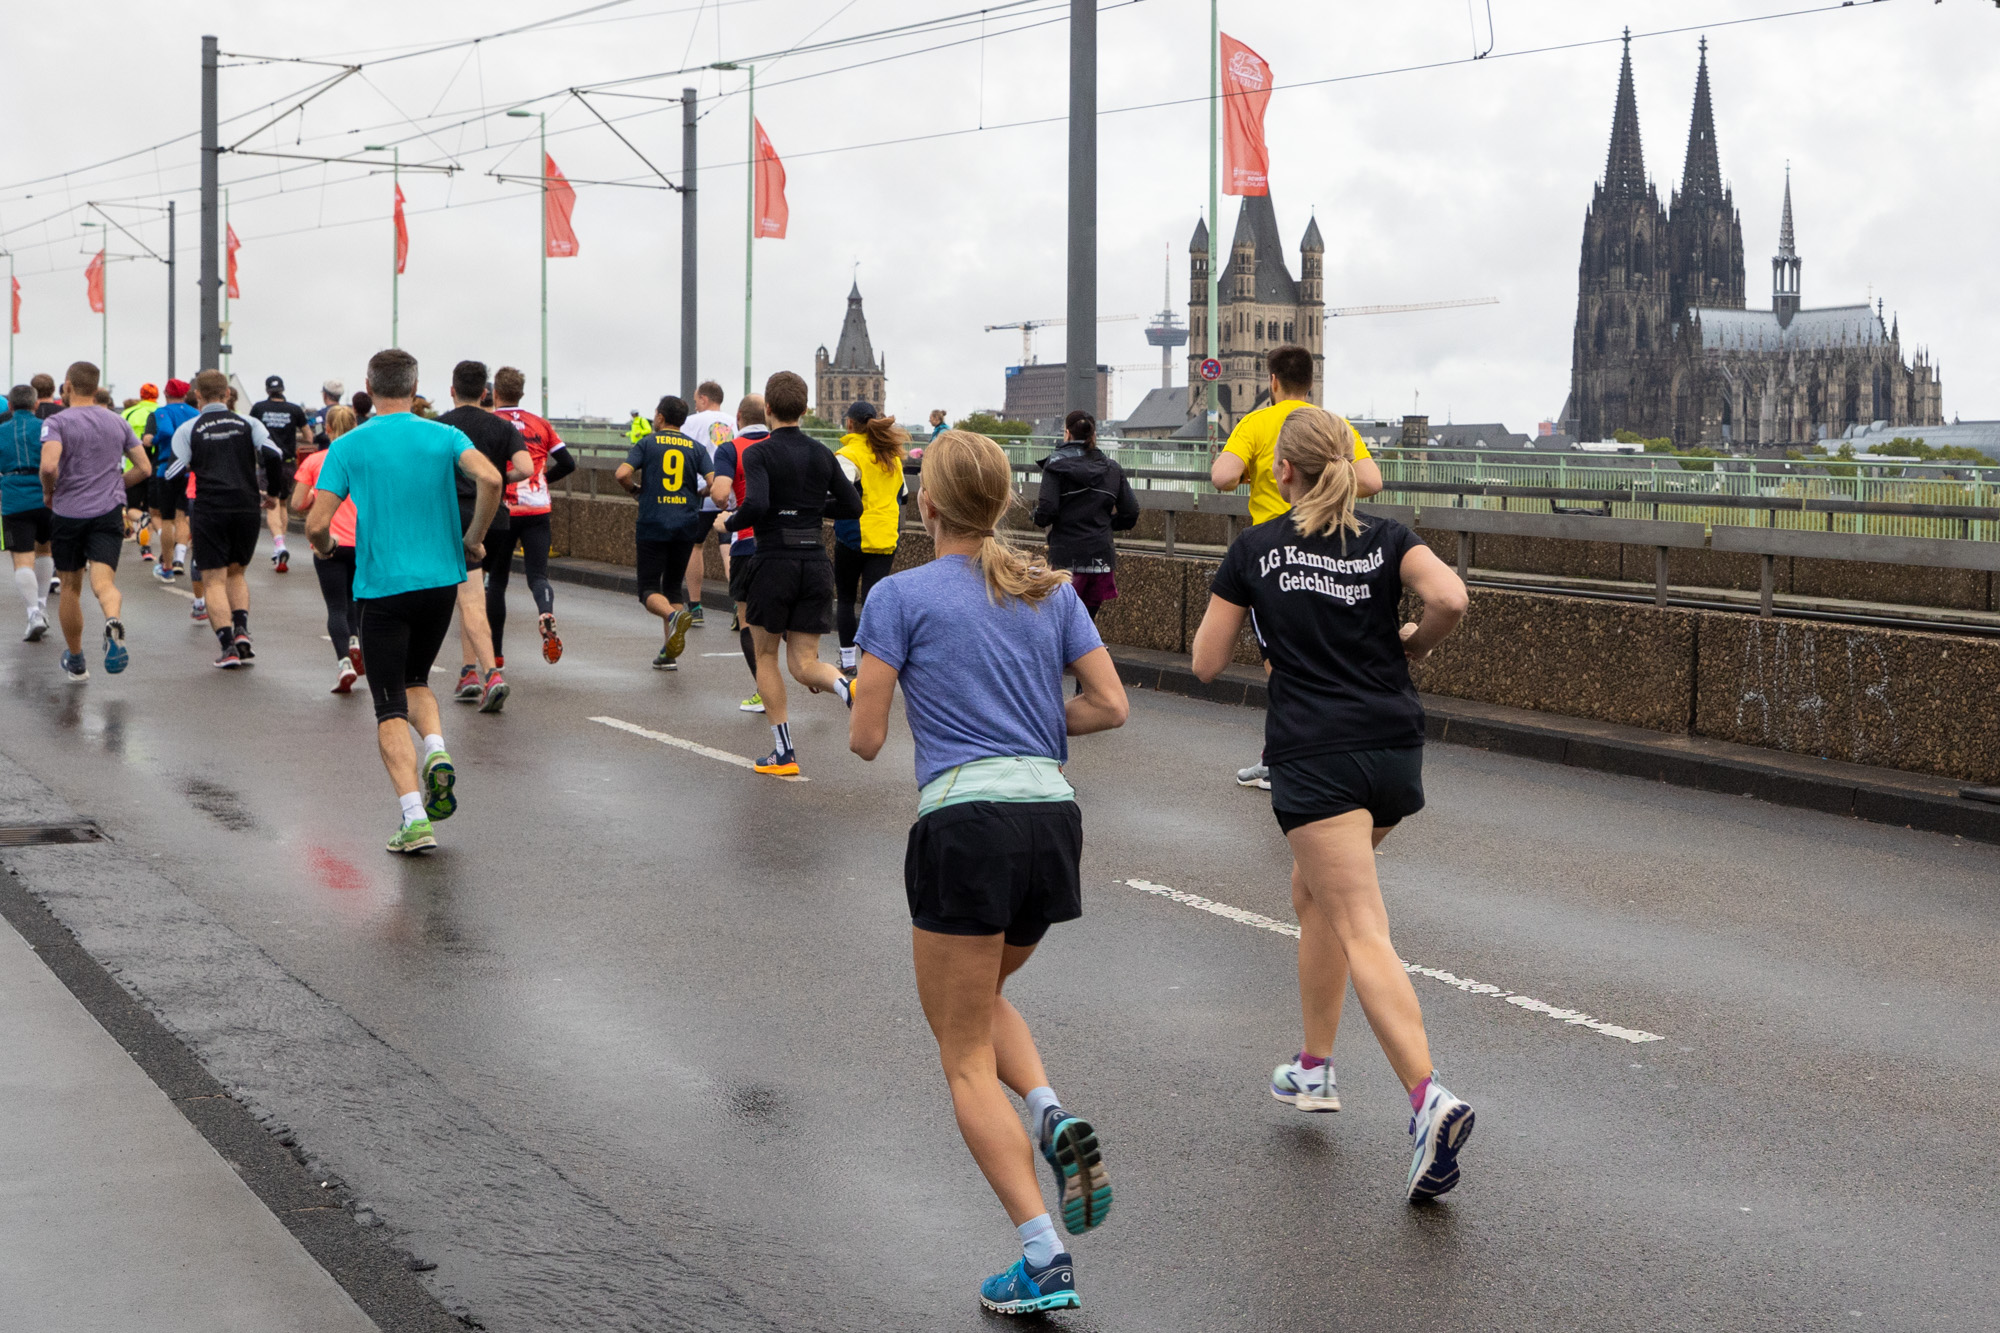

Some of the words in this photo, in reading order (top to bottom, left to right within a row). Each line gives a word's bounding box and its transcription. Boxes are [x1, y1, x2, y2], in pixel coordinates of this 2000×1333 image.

[655, 435, 694, 449] TERODDE
[662, 448, 685, 492] 9
[657, 496, 662, 504] 1.
[663, 496, 671, 504] FC
[671, 495, 687, 505] KÖLN
[1259, 548, 1281, 578] LG
[1284, 545, 1385, 575] Kammerwald
[1278, 570, 1371, 606] Geichlingen
